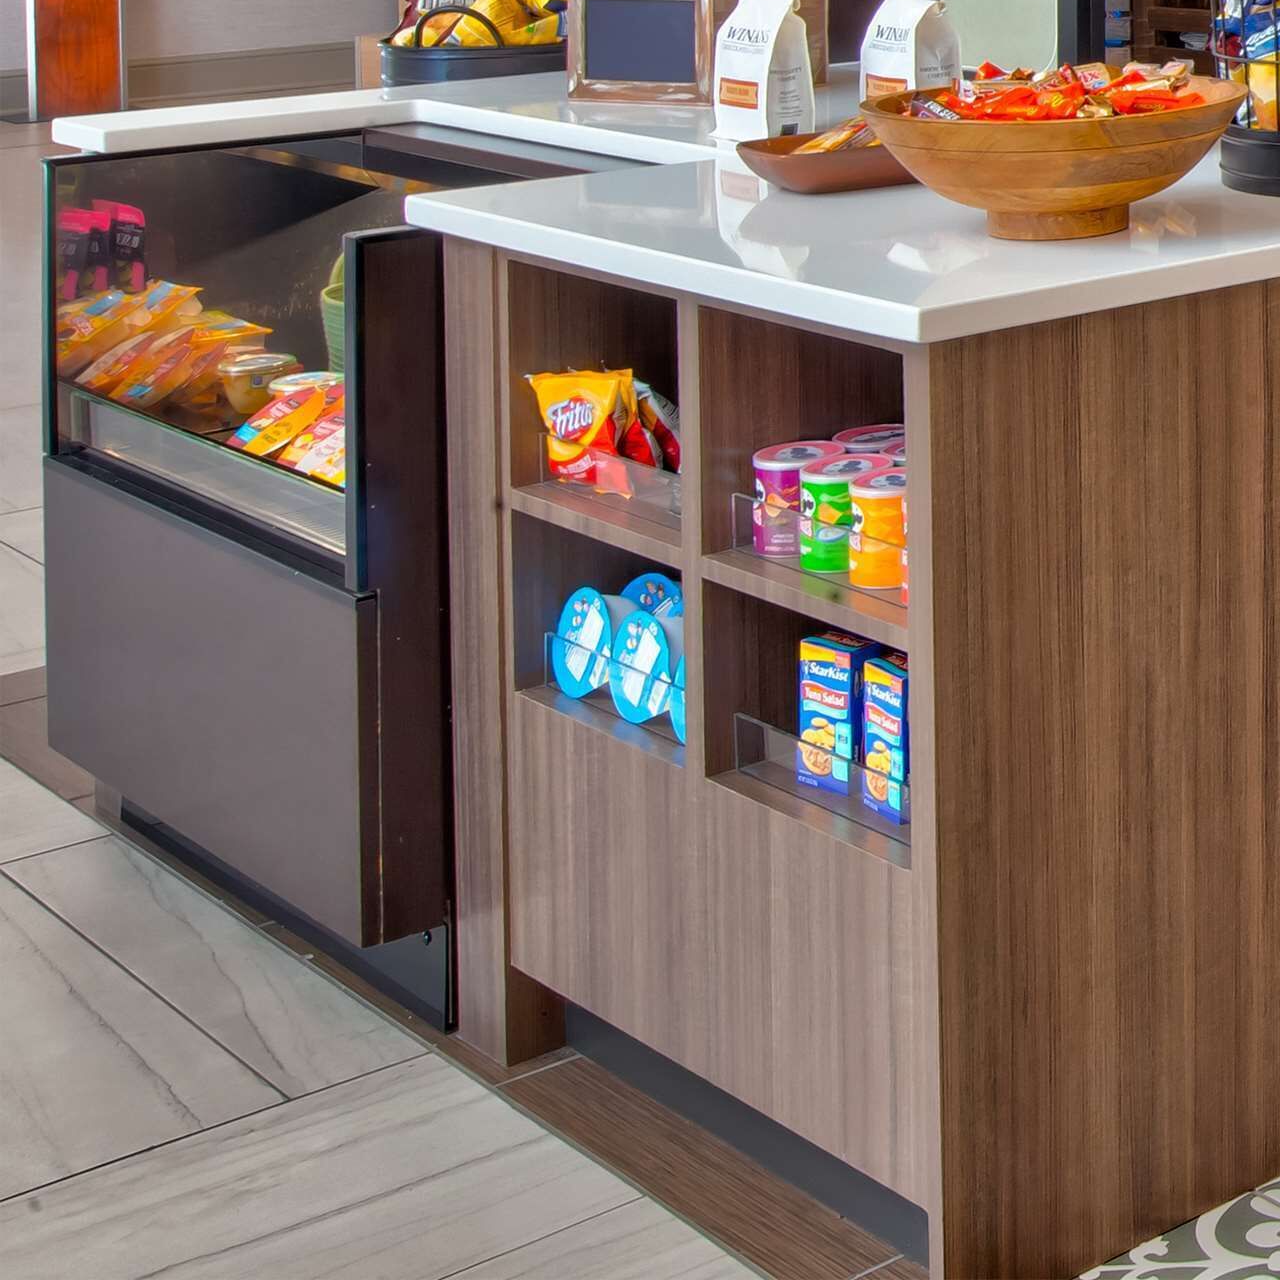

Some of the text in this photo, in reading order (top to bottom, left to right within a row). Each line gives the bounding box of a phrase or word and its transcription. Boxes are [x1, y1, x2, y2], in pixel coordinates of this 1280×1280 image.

[547, 400, 593, 440] Fritos
[809, 661, 850, 682] StarKist
[805, 686, 845, 707] Tuna Salad
[871, 684, 901, 708] StarKist
